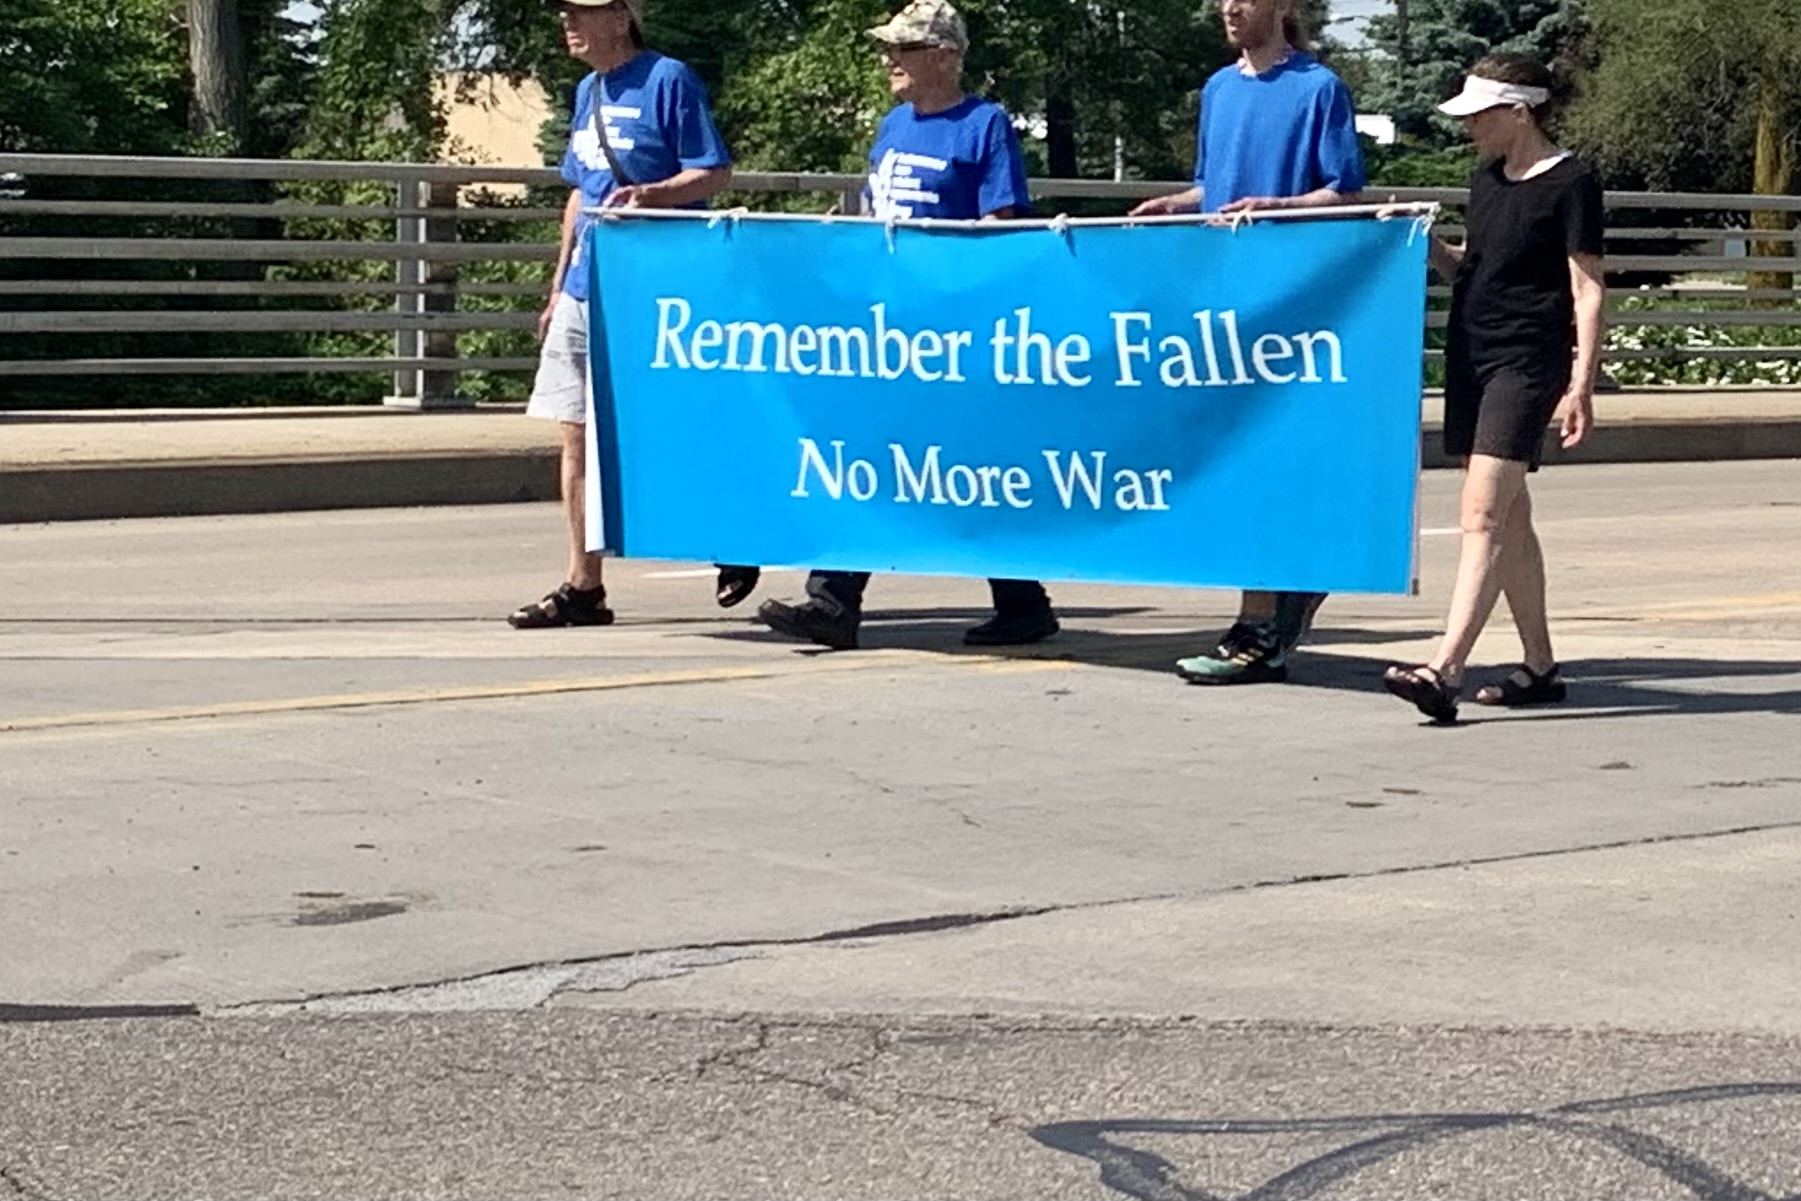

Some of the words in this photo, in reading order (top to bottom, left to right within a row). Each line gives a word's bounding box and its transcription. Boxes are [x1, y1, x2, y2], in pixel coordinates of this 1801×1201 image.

[651, 297, 972, 382] Remember
[990, 307, 1092, 387] the
[1109, 308, 1348, 387] Fallen
[790, 438, 878, 501] No
[889, 443, 1033, 508] More
[1042, 450, 1173, 511] War
